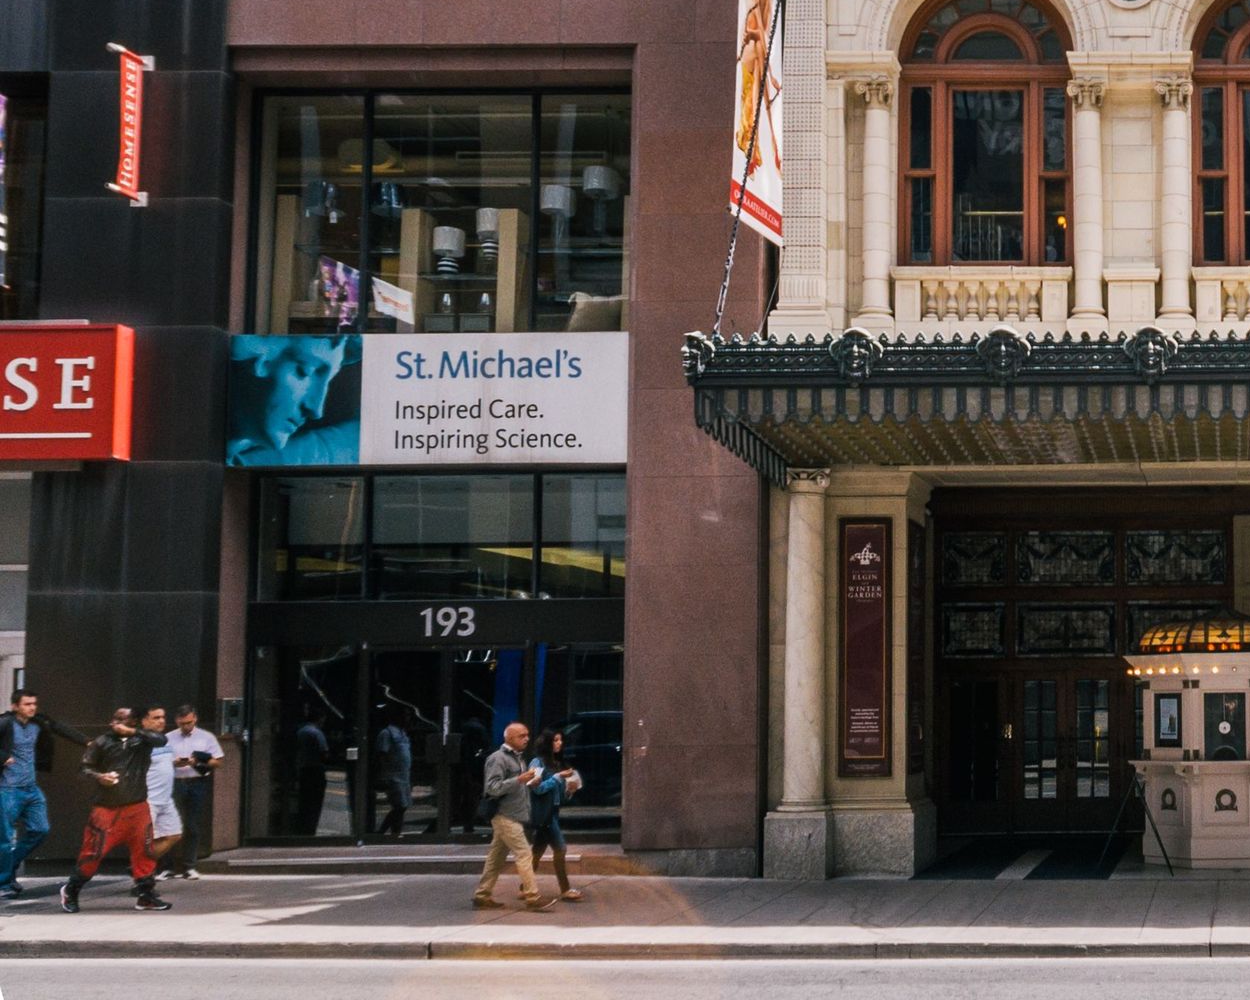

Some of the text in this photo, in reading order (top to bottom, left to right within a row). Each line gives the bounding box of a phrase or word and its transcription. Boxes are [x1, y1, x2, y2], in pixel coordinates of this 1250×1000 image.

[395, 349, 582, 379] St. Michael's
[395, 398, 544, 424] Inspired Care.
[394, 429, 583, 454] Inspiring Science.
[420, 606, 476, 638] 193
